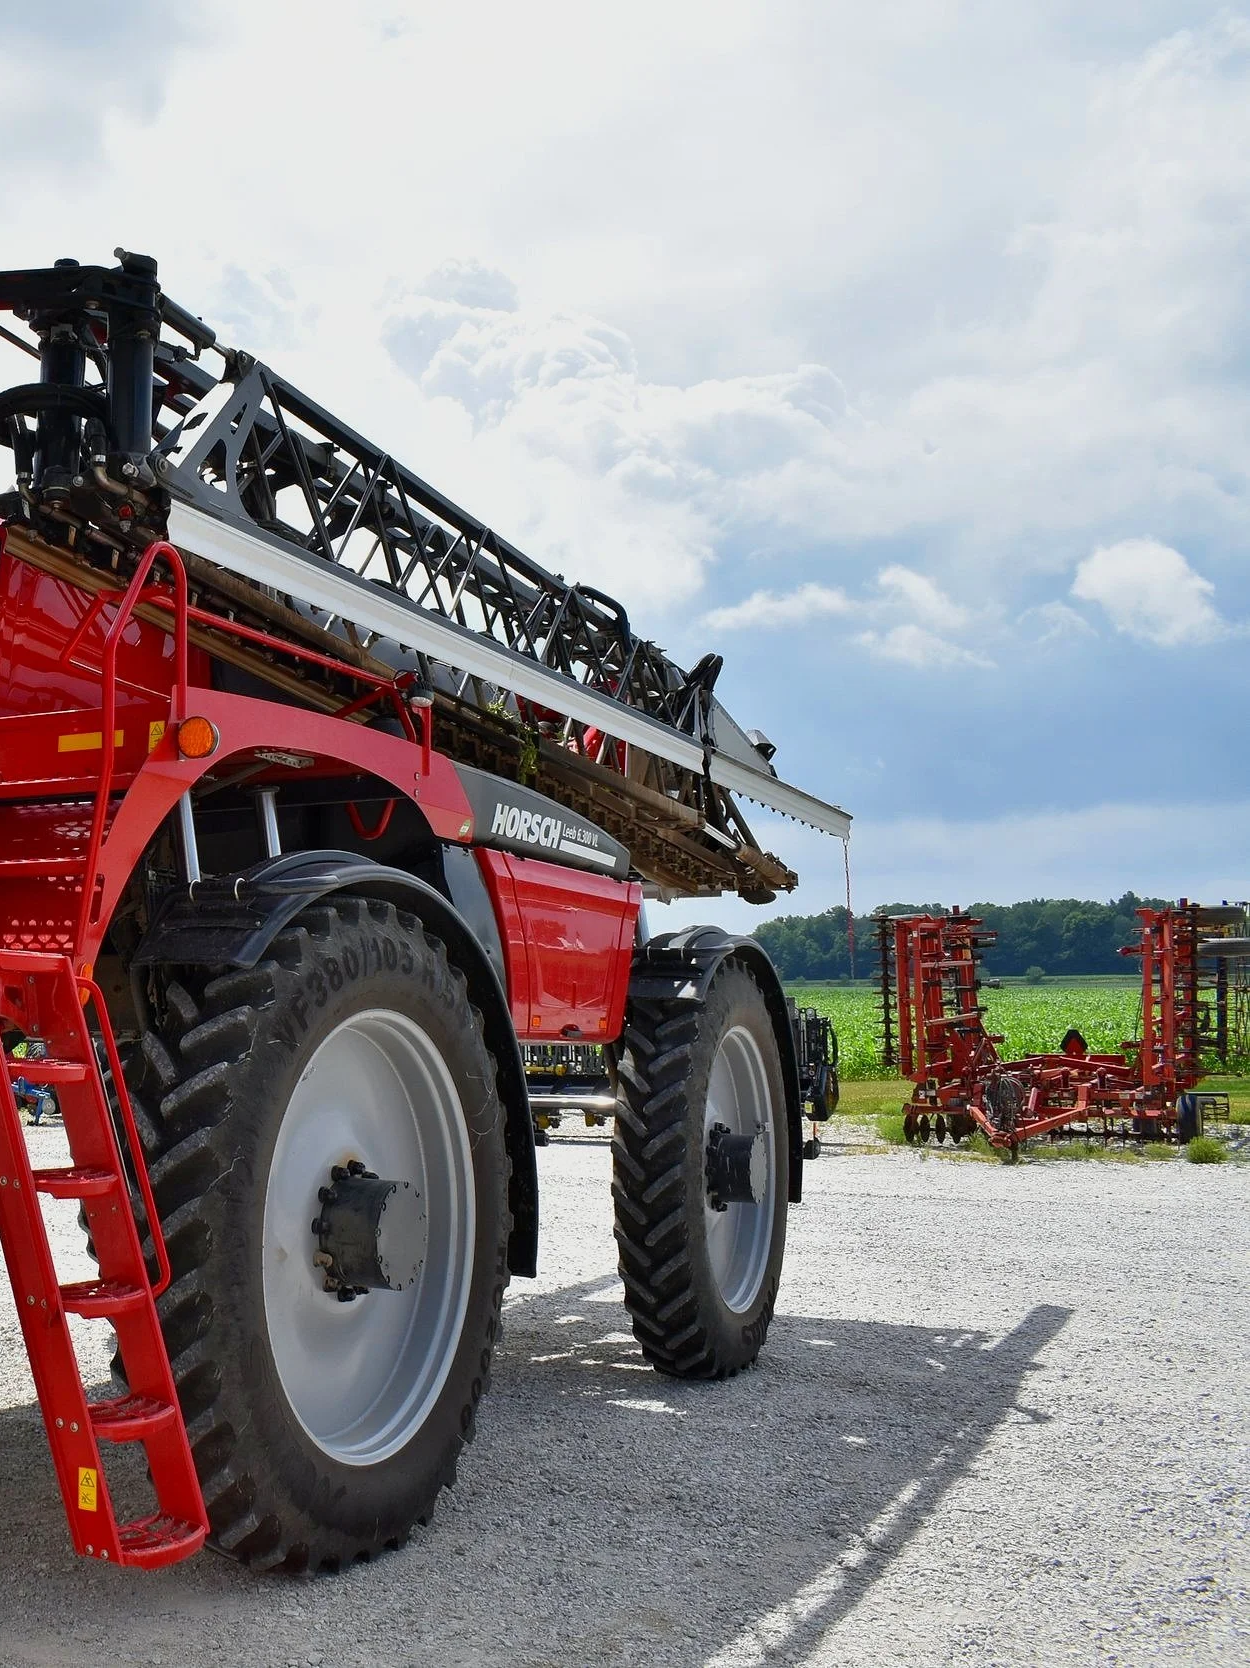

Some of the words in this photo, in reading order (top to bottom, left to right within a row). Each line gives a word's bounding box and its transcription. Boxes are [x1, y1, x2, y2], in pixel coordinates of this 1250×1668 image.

[491, 803, 562, 849] HORSCH
[562, 823, 577, 840] Leeb
[577, 828, 592, 845] 6.300
